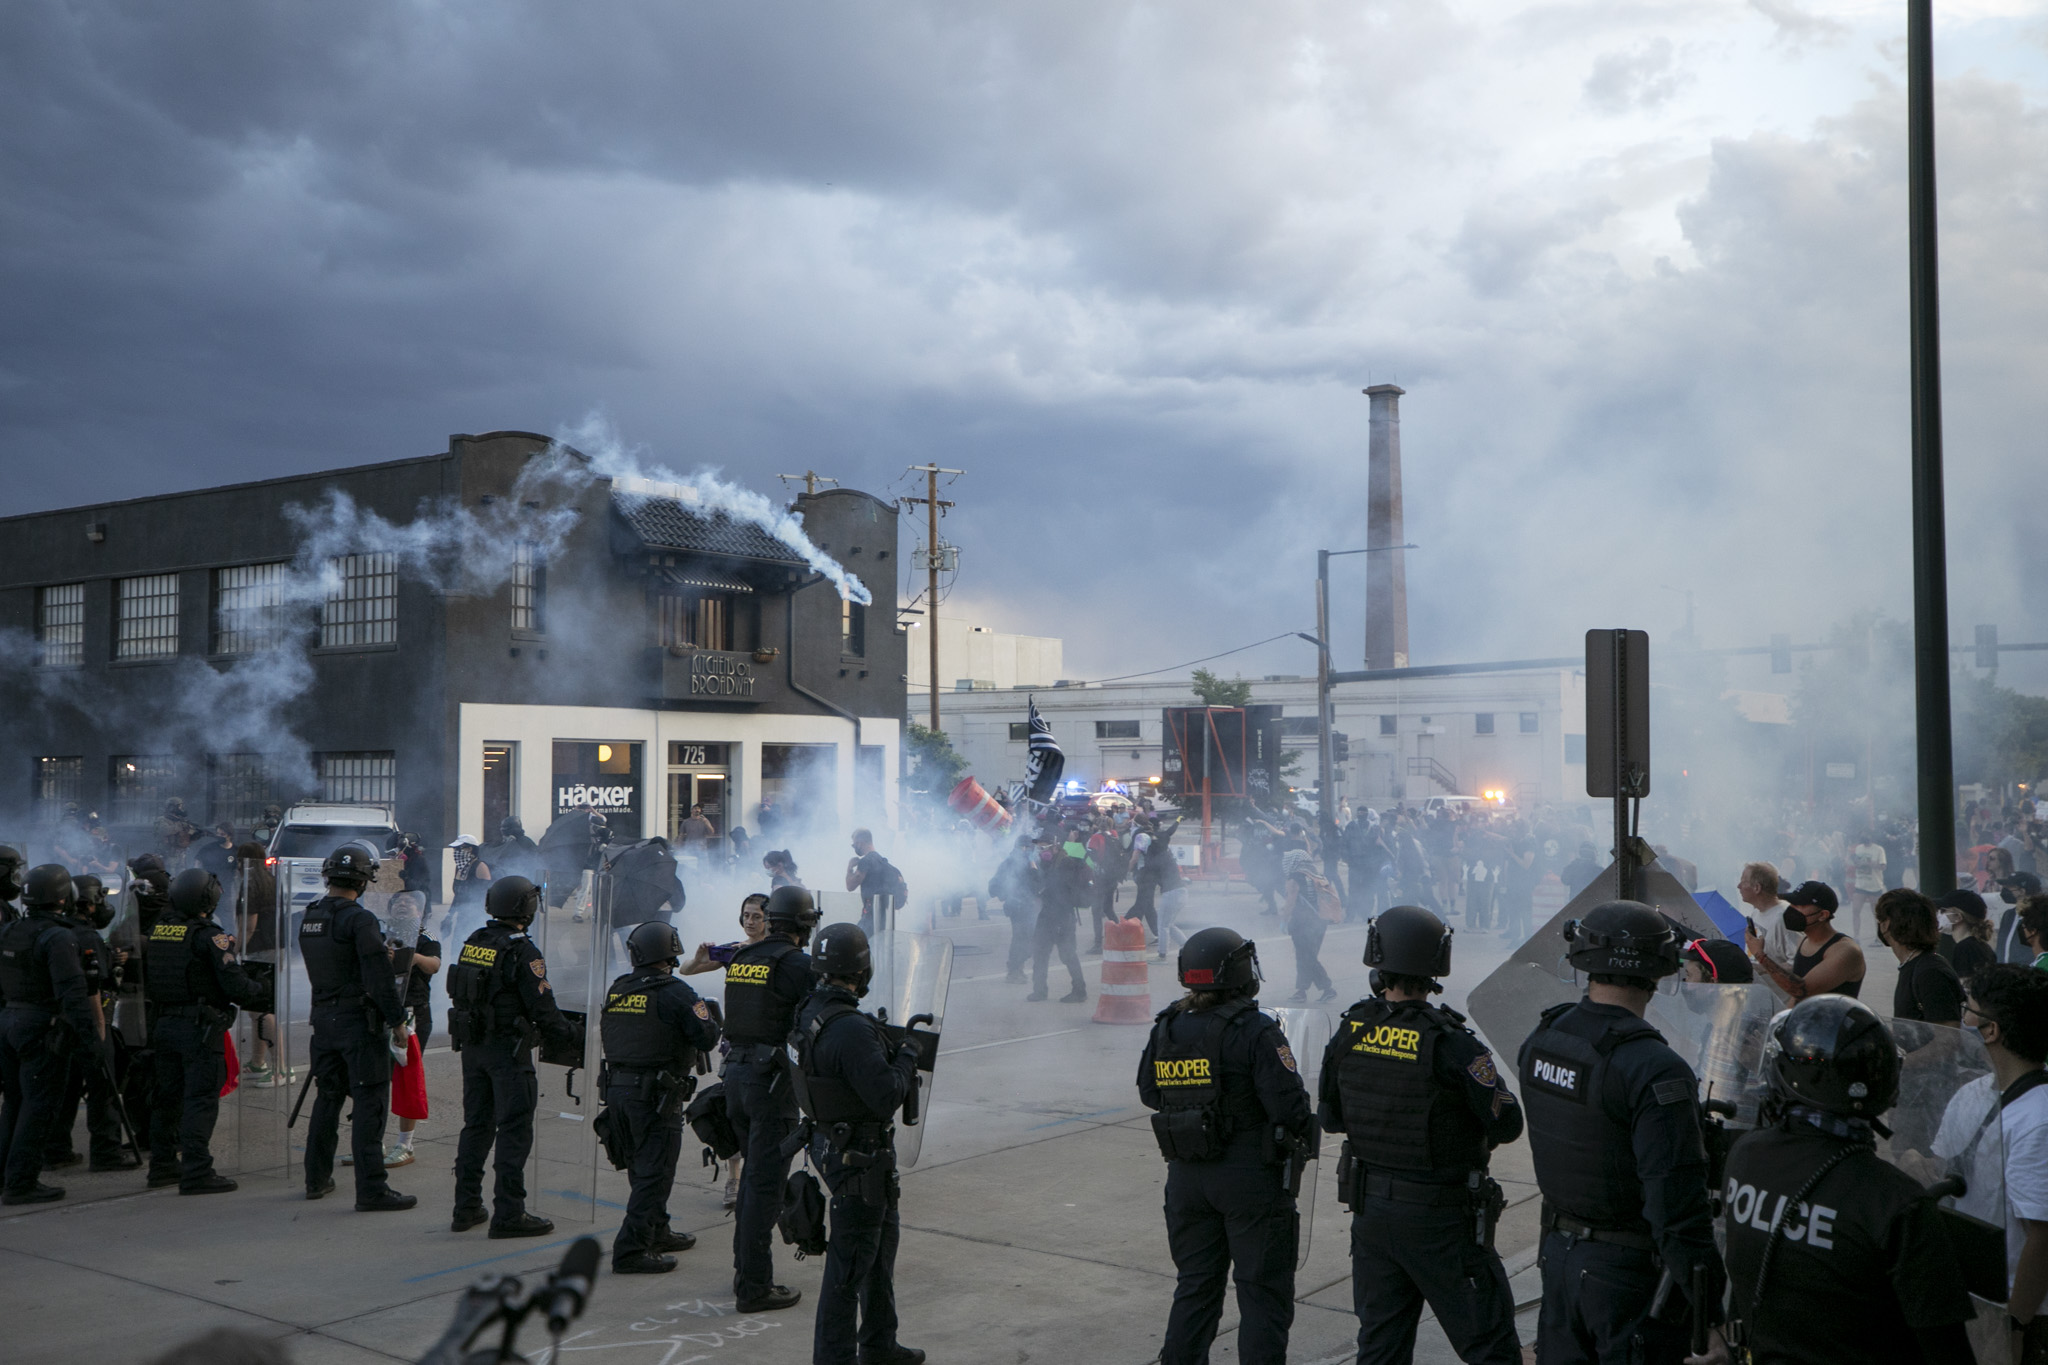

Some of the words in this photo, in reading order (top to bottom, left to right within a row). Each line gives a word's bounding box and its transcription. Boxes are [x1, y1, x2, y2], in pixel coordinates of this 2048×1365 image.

[692, 655, 736, 675] KITCHENS
[691, 675, 755, 696] BROADWAY
[684, 746, 706, 765] 725
[341, 855, 352, 865] 3
[153, 924, 188, 937] TROOPER
[302, 923, 322, 933] POLICE
[463, 944, 497, 962] TROOPER
[820, 938, 829, 953] 1
[727, 963, 771, 979] TROOPER
[1350, 1020, 1420, 1052] TOOPER
[1154, 1058, 1211, 1079] TROOPER
[1533, 1059, 1577, 1090] POLICE
[1726, 1176, 1838, 1250] POLICE
